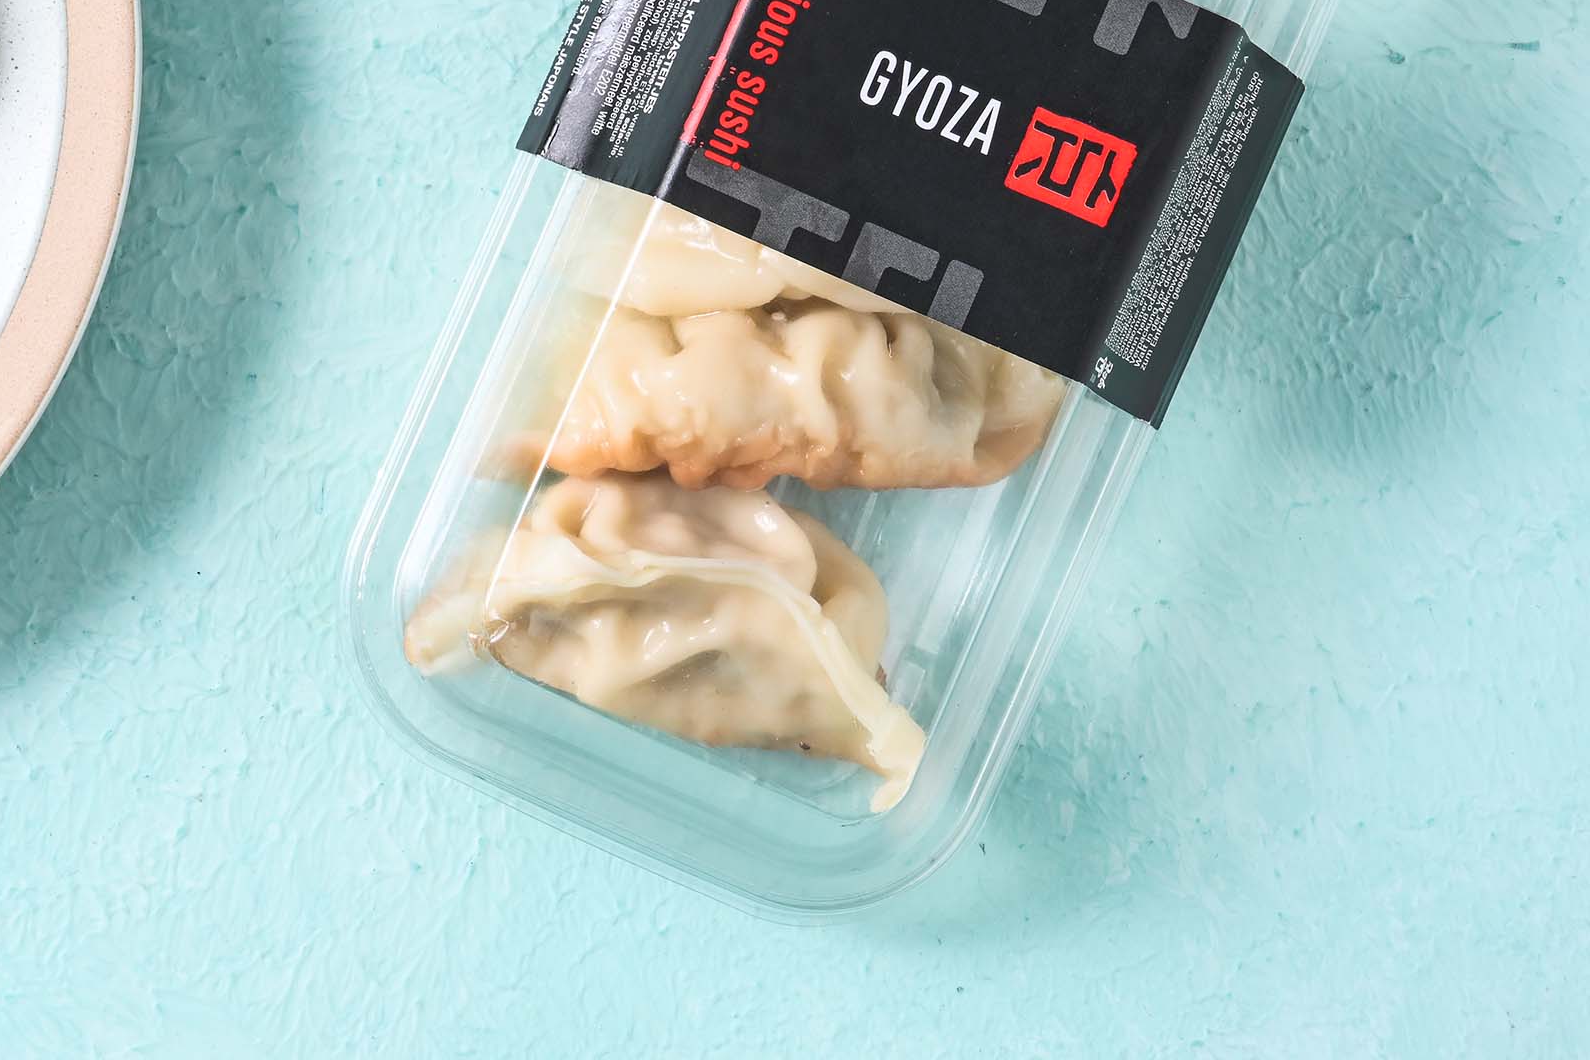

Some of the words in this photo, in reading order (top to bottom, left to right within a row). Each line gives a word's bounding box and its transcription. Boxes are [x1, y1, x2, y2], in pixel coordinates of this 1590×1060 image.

[563, 2, 589, 48] STYLE
[590, 15, 602, 30] en
[637, 28, 654, 54] zout,
[570, 30, 596, 78] mosterd.
[600, 43, 637, 110] maïszetmeel,
[642, 7, 695, 115] KIPPASTEITJES
[532, 47, 568, 117] JAPONAIS
[603, 54, 643, 129] gehydrolyseerd
[859, 50, 1002, 156] GYOZA
[590, 109, 609, 136] witte
[608, 96, 632, 143] sojasaus
[704, 71, 766, 171] sushi
[1237, 104, 1260, 141] Deckel.
[1219, 170, 1231, 188] bis:
[1124, 335, 1139, 360] Kann
[1135, 311, 1150, 334] heiß
[1145, 287, 1160, 311] oder
[1156, 267, 1168, 286] kalt
[1164, 219, 1191, 266] gegessen
[1185, 178, 1207, 217] werden.
[1203, 128, 1229, 175] Entfernen
[1224, 110, 1236, 127] Sie
[1232, 92, 1244, 109] die
[1128, 307, 1159, 364] Verpackung
[1154, 288, 1166, 305] vor
[1161, 264, 1176, 287] dem
[1171, 211, 1200, 263] Erwärmen.
[1195, 155, 1225, 208] Erwärmen:
[1223, 110, 1243, 144] Minute
[1238, 92, 1251, 109] bei
[1246, 71, 1260, 91] 800
[1132, 343, 1148, 367] Watt
[1144, 332, 1153, 342] in
[1149, 314, 1162, 331] der
[1156, 257, 1187, 313] Mikrowelle.
[1182, 216, 1205, 255] Gekühlt
[1199, 184, 1219, 216] lagern
[1214, 165, 1226, 183] von
[1230, 128, 1242, 144] bis
[1247, 78, 1264, 104] Nicht
[1196, 189, 1225, 238] verzehren
[1191, 238, 1202, 252] Zu
[1119, 300, 1150, 359] consommer
[1165, 232, 1177, 251] Voir
[1174, 214, 1185, 231] sur
[1181, 202, 1189, 212] le
[1170, 254, 1196, 300] geeignet.
[1149, 300, 1175, 347] Einfrieren
[1139, 348, 1153, 370] zum
